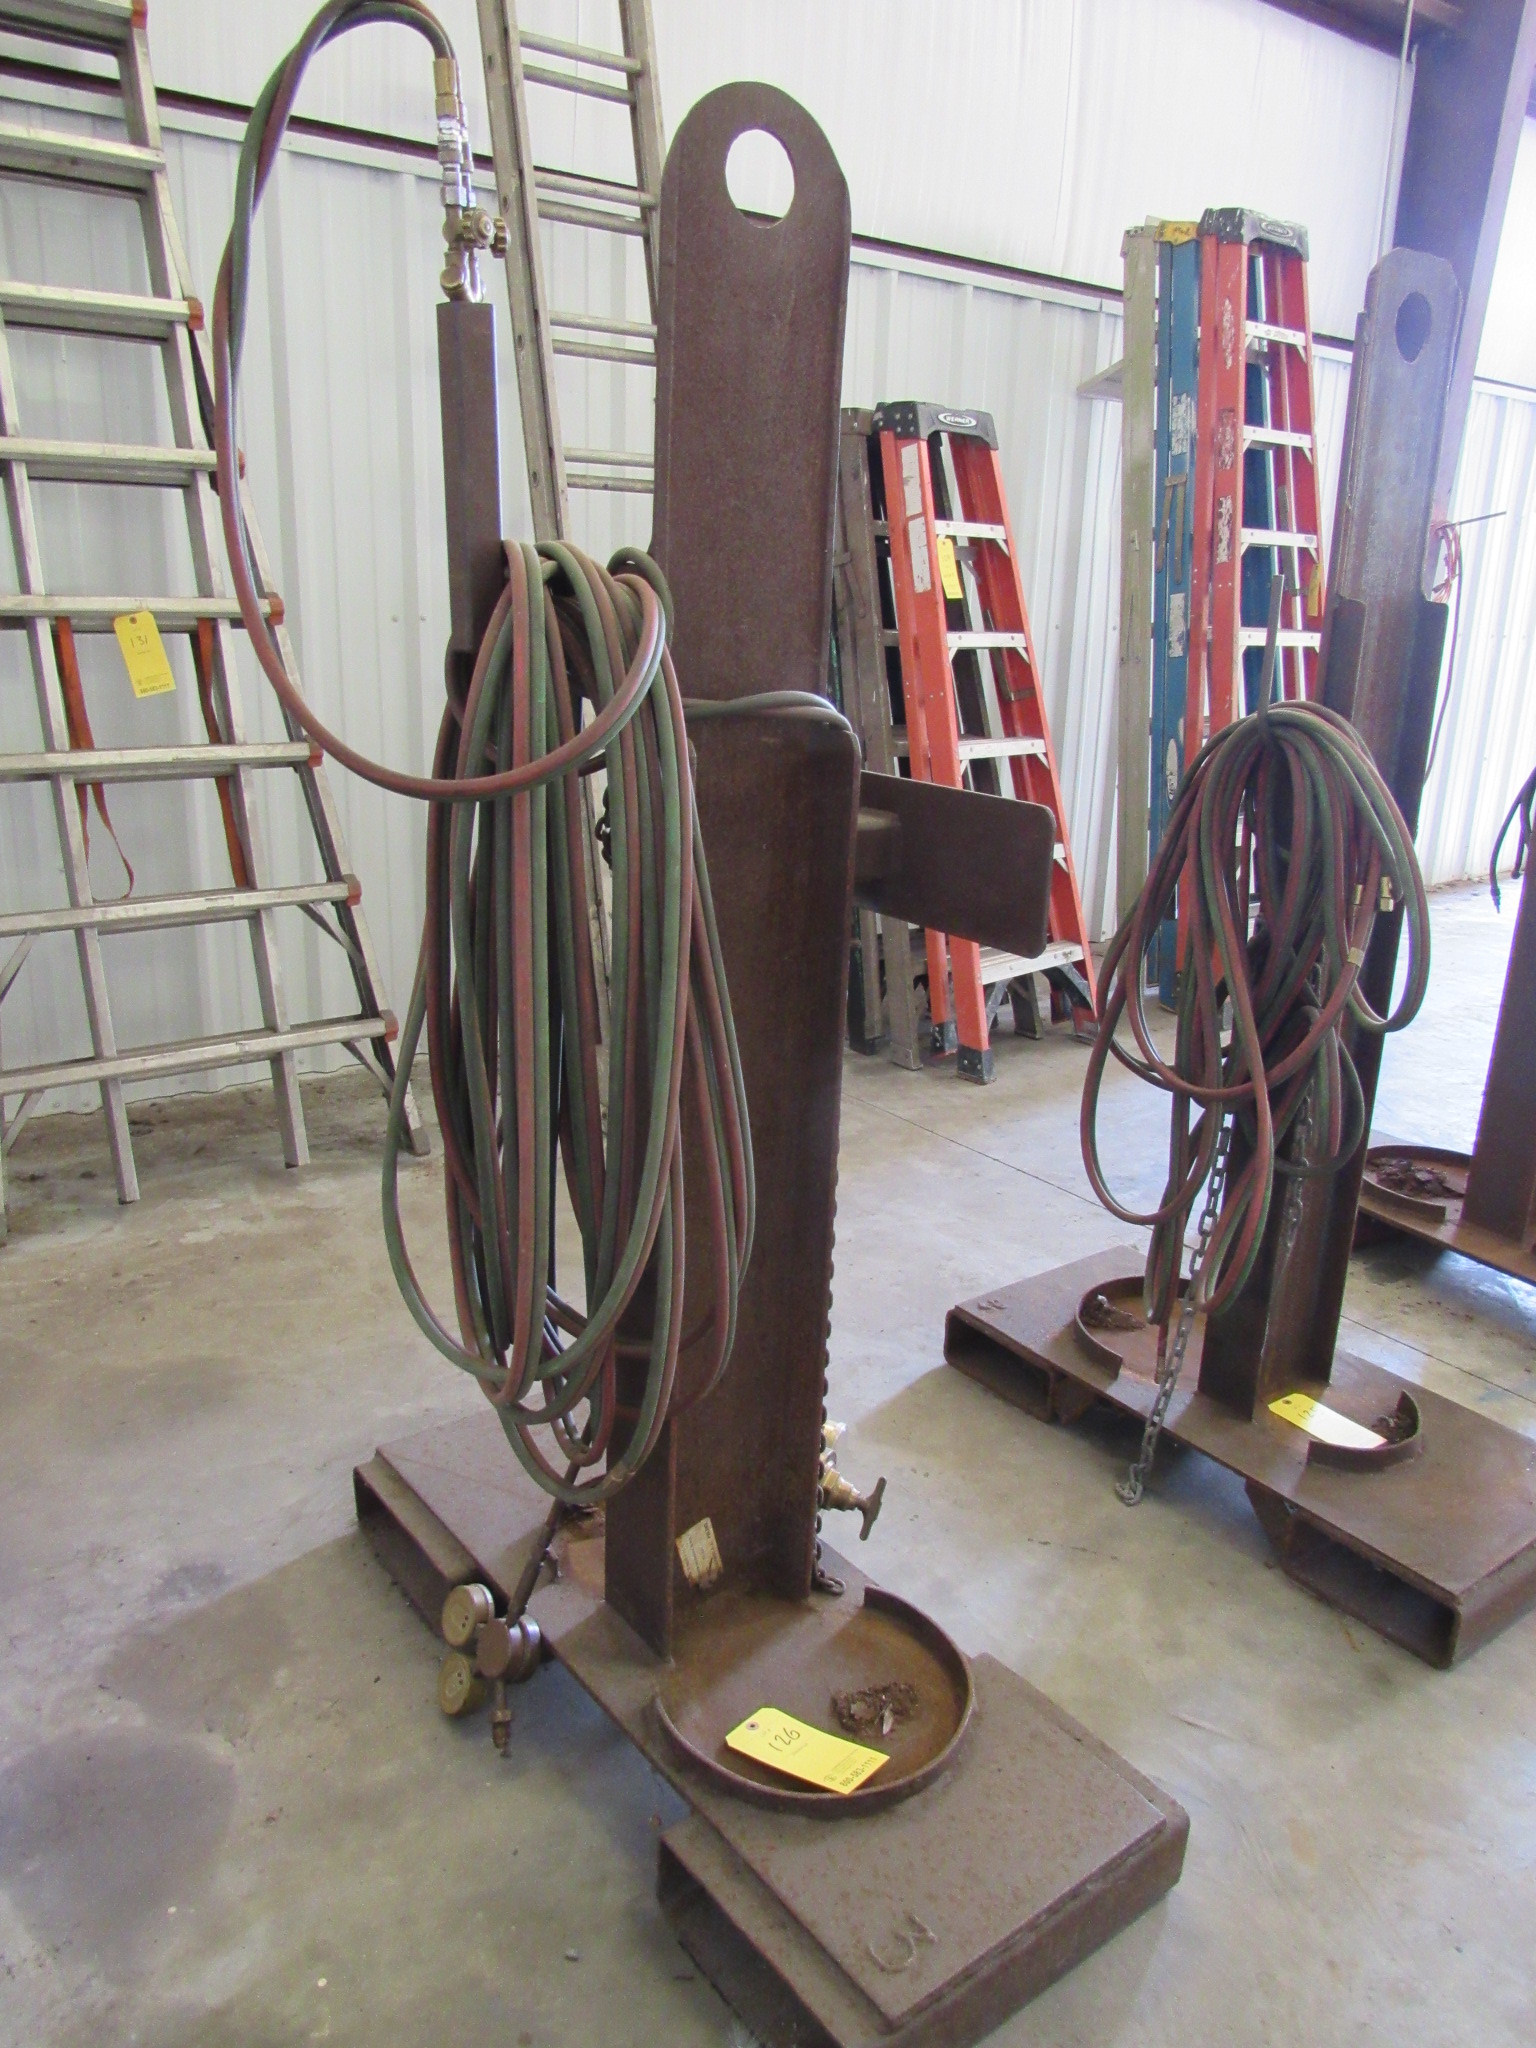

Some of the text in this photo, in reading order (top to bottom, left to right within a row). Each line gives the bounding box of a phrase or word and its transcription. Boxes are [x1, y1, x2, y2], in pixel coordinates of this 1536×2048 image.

[130, 635, 148, 648] 131
[768, 1727, 801, 1752] 126
[839, 1756, 878, 1787] 800-583-1111
